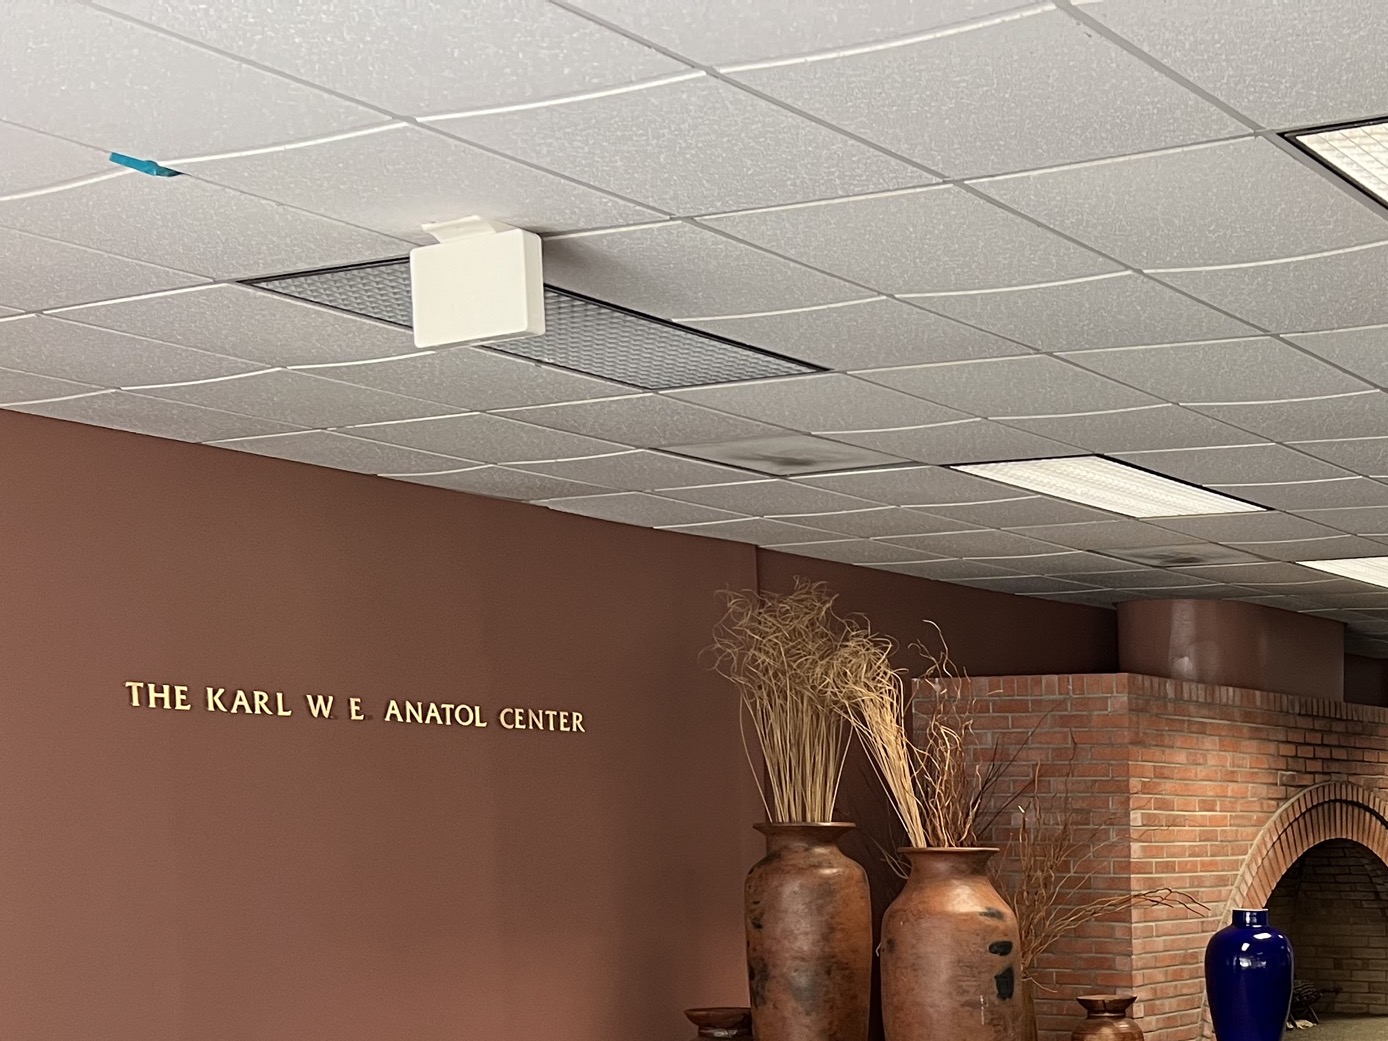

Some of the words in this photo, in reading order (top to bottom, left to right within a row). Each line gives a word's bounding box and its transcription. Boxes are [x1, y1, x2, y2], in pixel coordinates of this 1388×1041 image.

[124, 681, 192, 711] THE
[206, 687, 292, 716] KARL
[306, 694, 335, 719] W
[350, 697, 365, 720] E
[384, 700, 488, 728] ANATOL
[499, 708, 586, 733] CENTER
